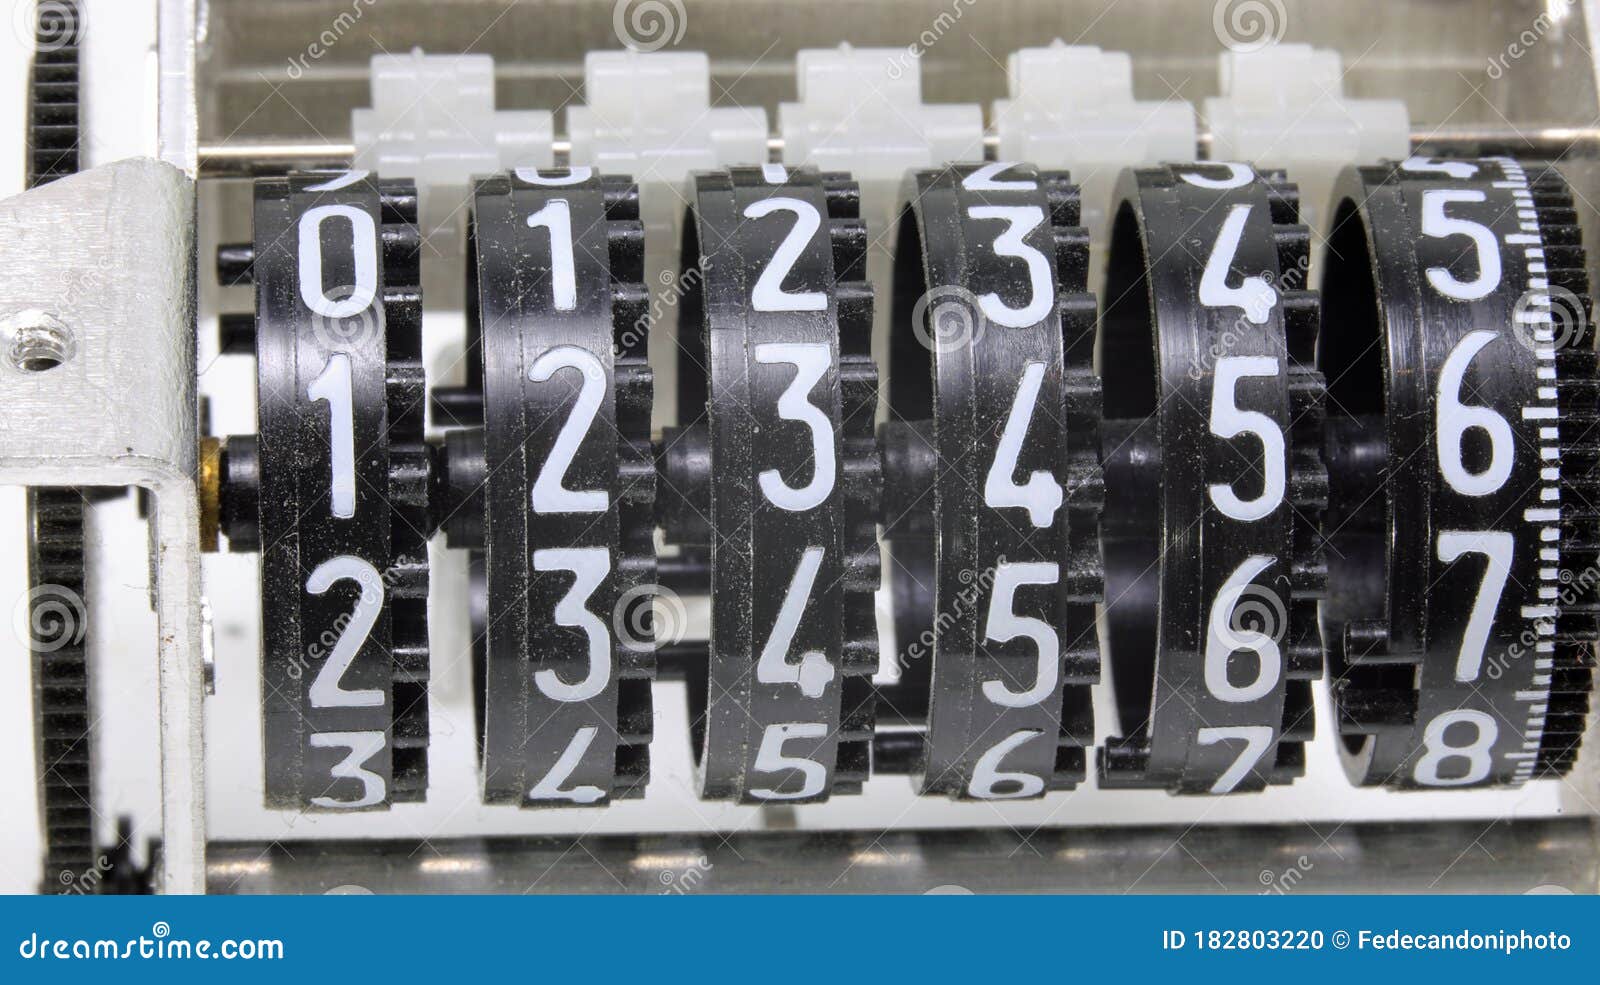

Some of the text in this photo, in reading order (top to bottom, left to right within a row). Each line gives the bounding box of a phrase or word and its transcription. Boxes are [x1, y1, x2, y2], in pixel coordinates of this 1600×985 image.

[299, 190, 1501, 328] 0 1 2 3 4 5
[308, 329, 1515, 528] 1 2 3 4 5 6
[305, 531, 1514, 708] 2 3 4 5 6 7
[310, 709, 1498, 808] 3 4 5 6 7 8
